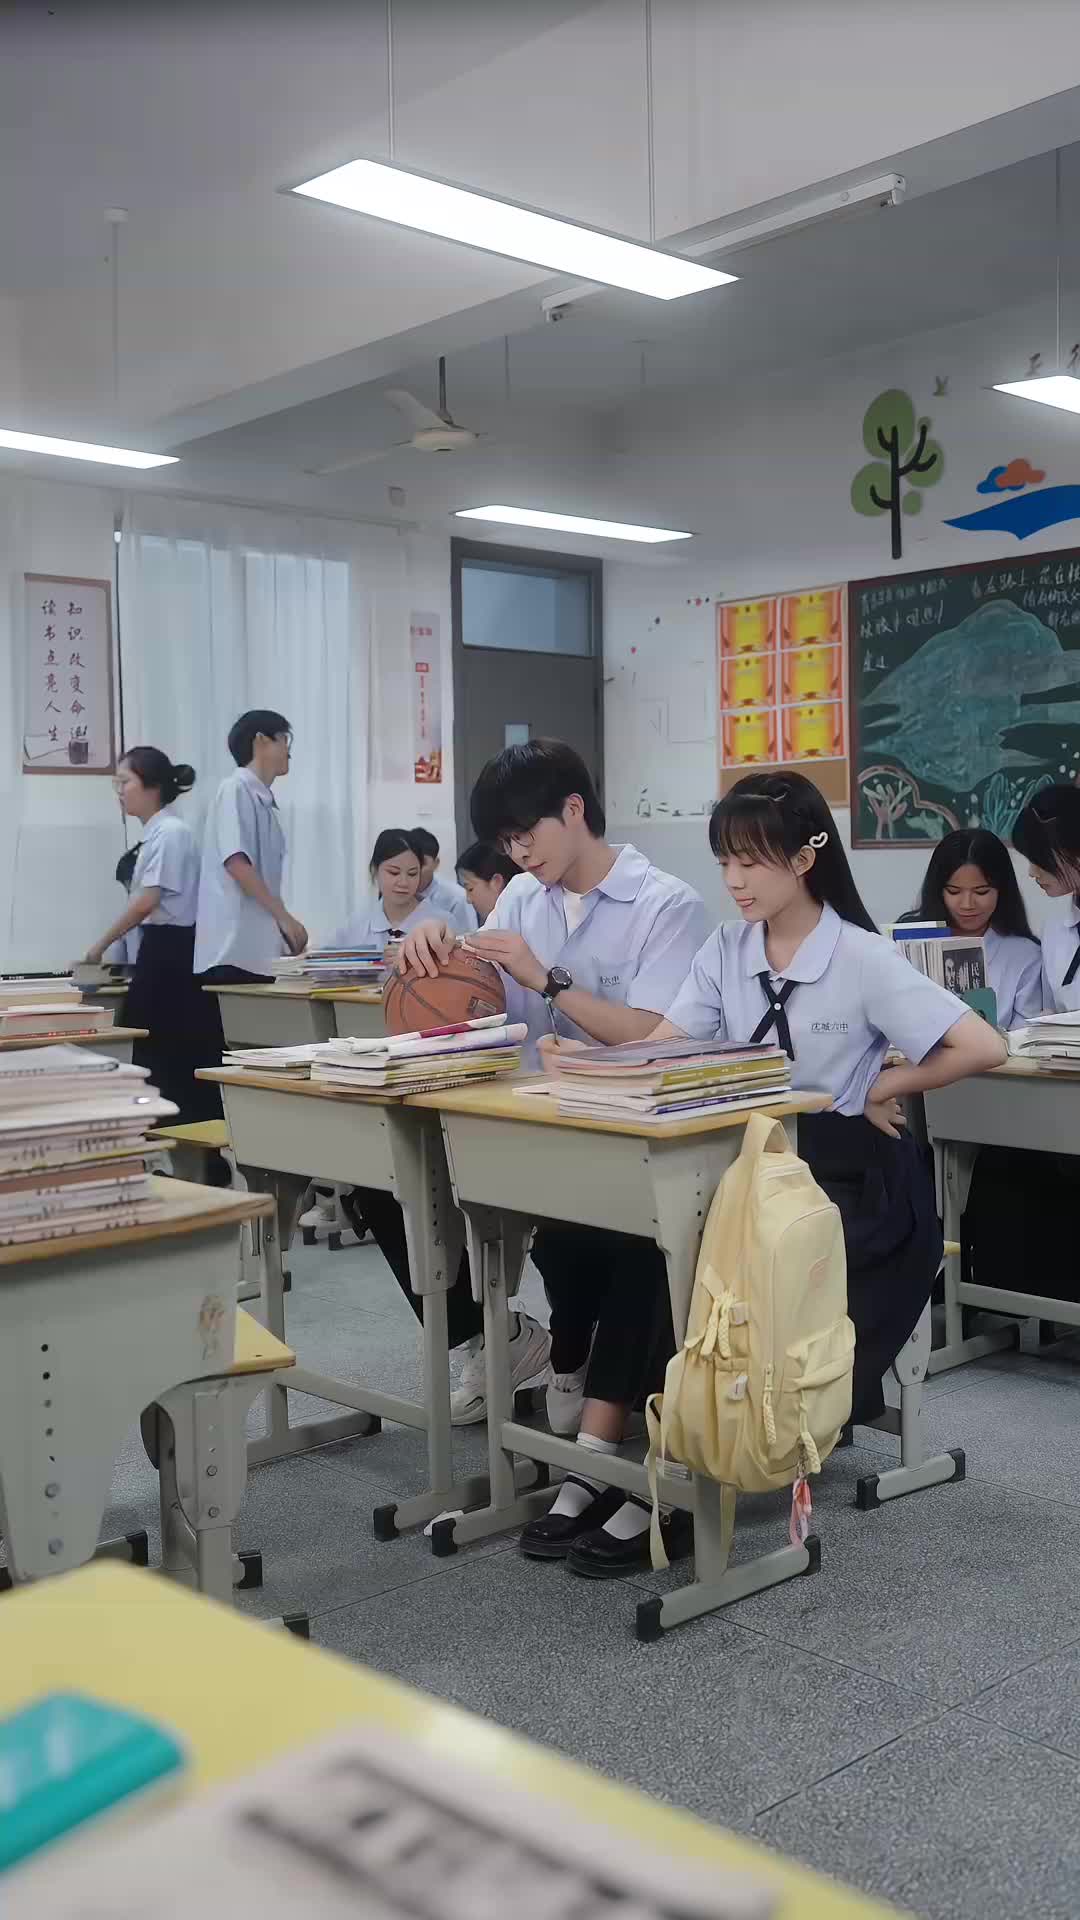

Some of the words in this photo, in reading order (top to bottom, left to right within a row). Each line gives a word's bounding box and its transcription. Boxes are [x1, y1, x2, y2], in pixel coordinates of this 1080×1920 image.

[41, 599, 61, 741] 读书点亮人生
